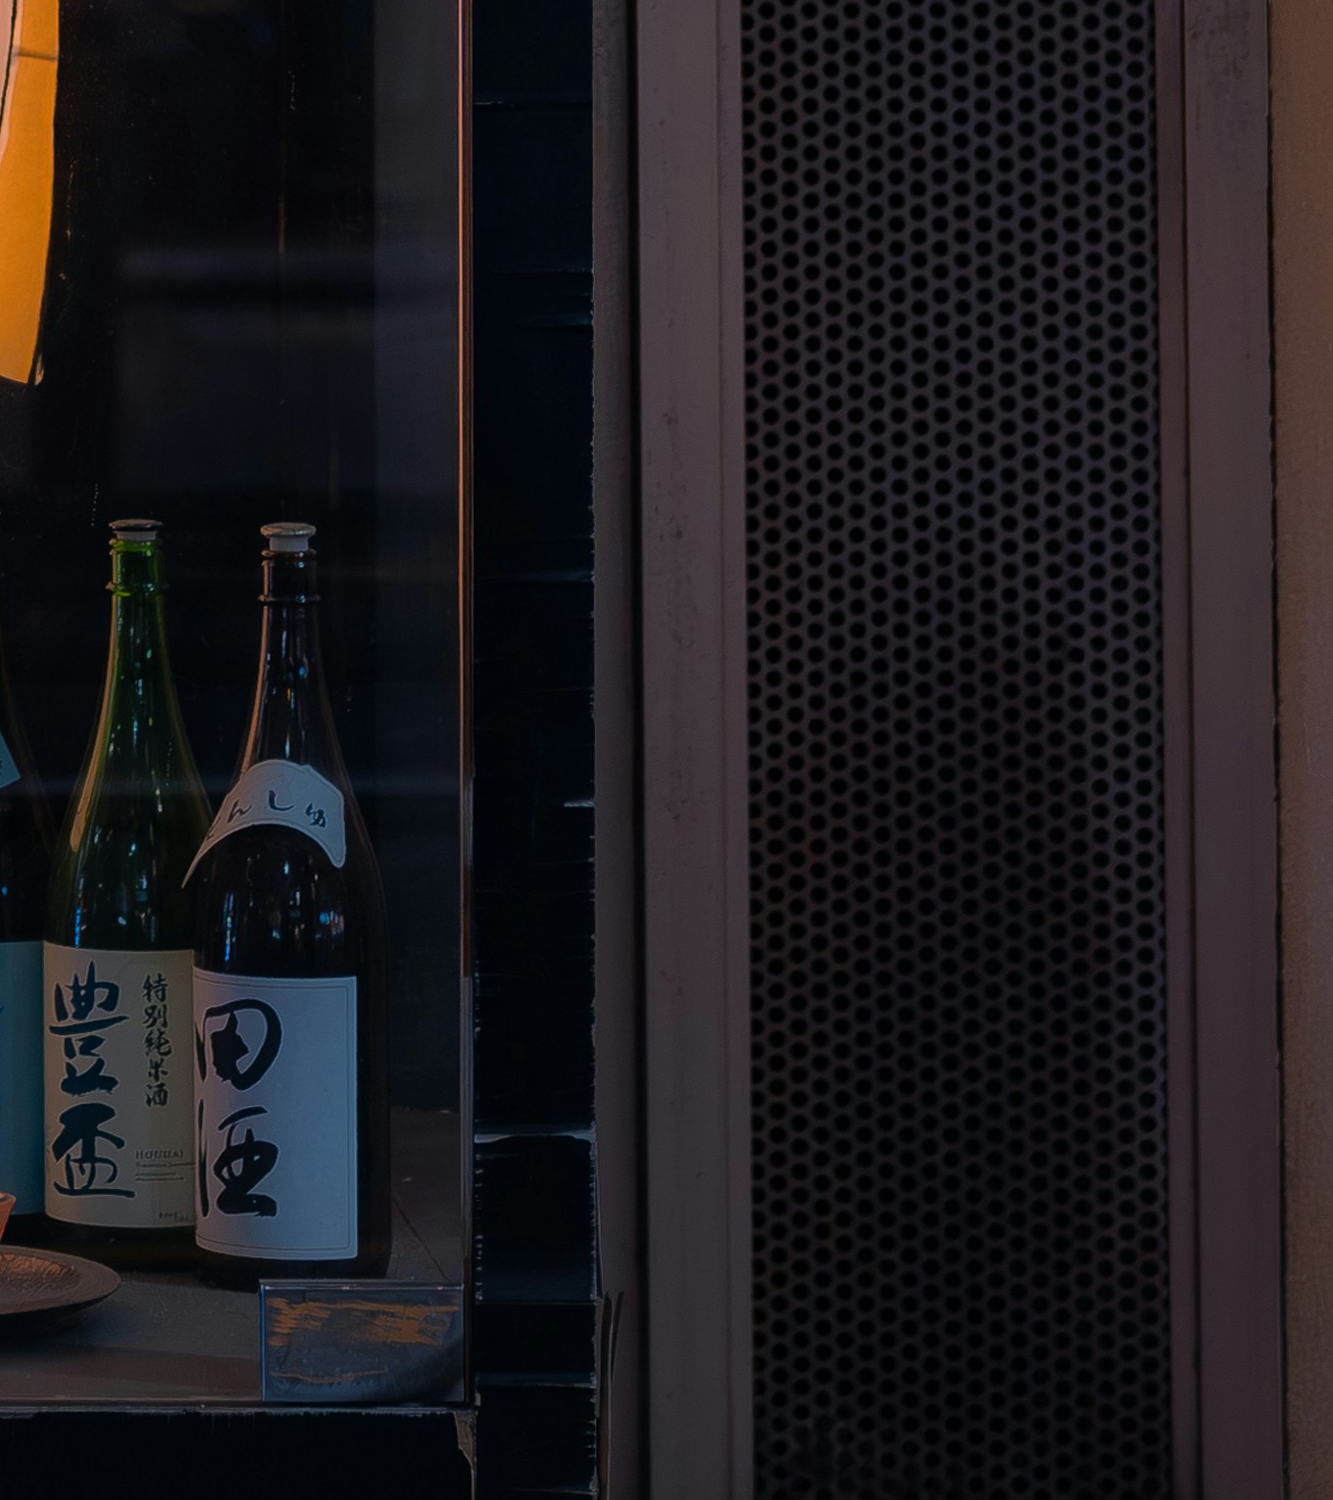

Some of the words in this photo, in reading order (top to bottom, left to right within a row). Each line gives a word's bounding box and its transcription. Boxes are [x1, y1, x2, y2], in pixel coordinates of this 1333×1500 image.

[141, 972, 173, 1107] 特別純米酒
